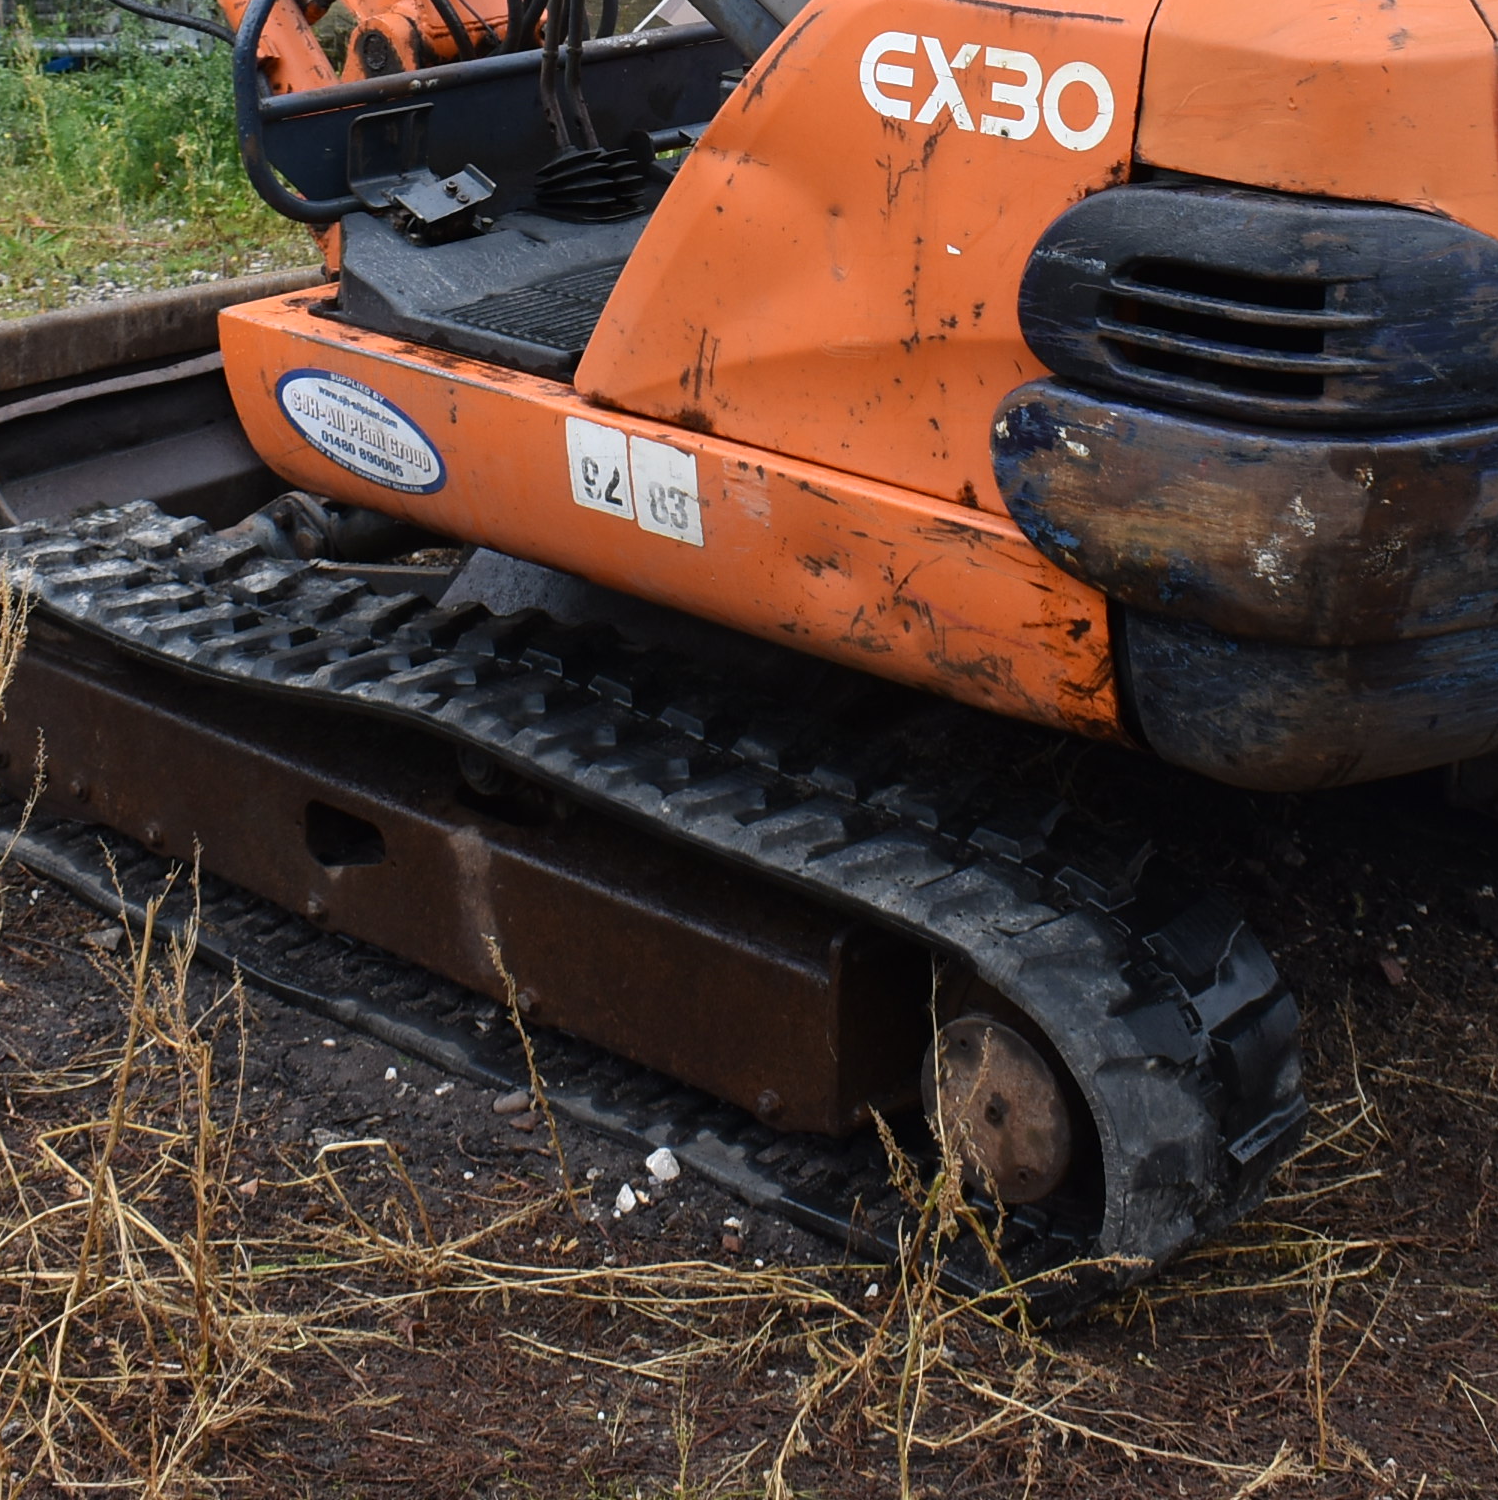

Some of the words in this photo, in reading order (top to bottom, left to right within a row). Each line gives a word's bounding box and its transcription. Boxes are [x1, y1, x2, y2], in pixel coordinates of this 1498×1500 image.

[859, 31, 1115, 152] EX30
[330, 372, 371, 395] SUPPLIED
[372, 392, 386, 403] BY
[291, 388, 346, 434] SJH-All
[349, 417, 387, 452] Plant
[387, 432, 432, 473] Group
[321, 430, 356, 456] 01480
[359, 447, 405, 478] 890005
[648, 481, 689, 530] 83
